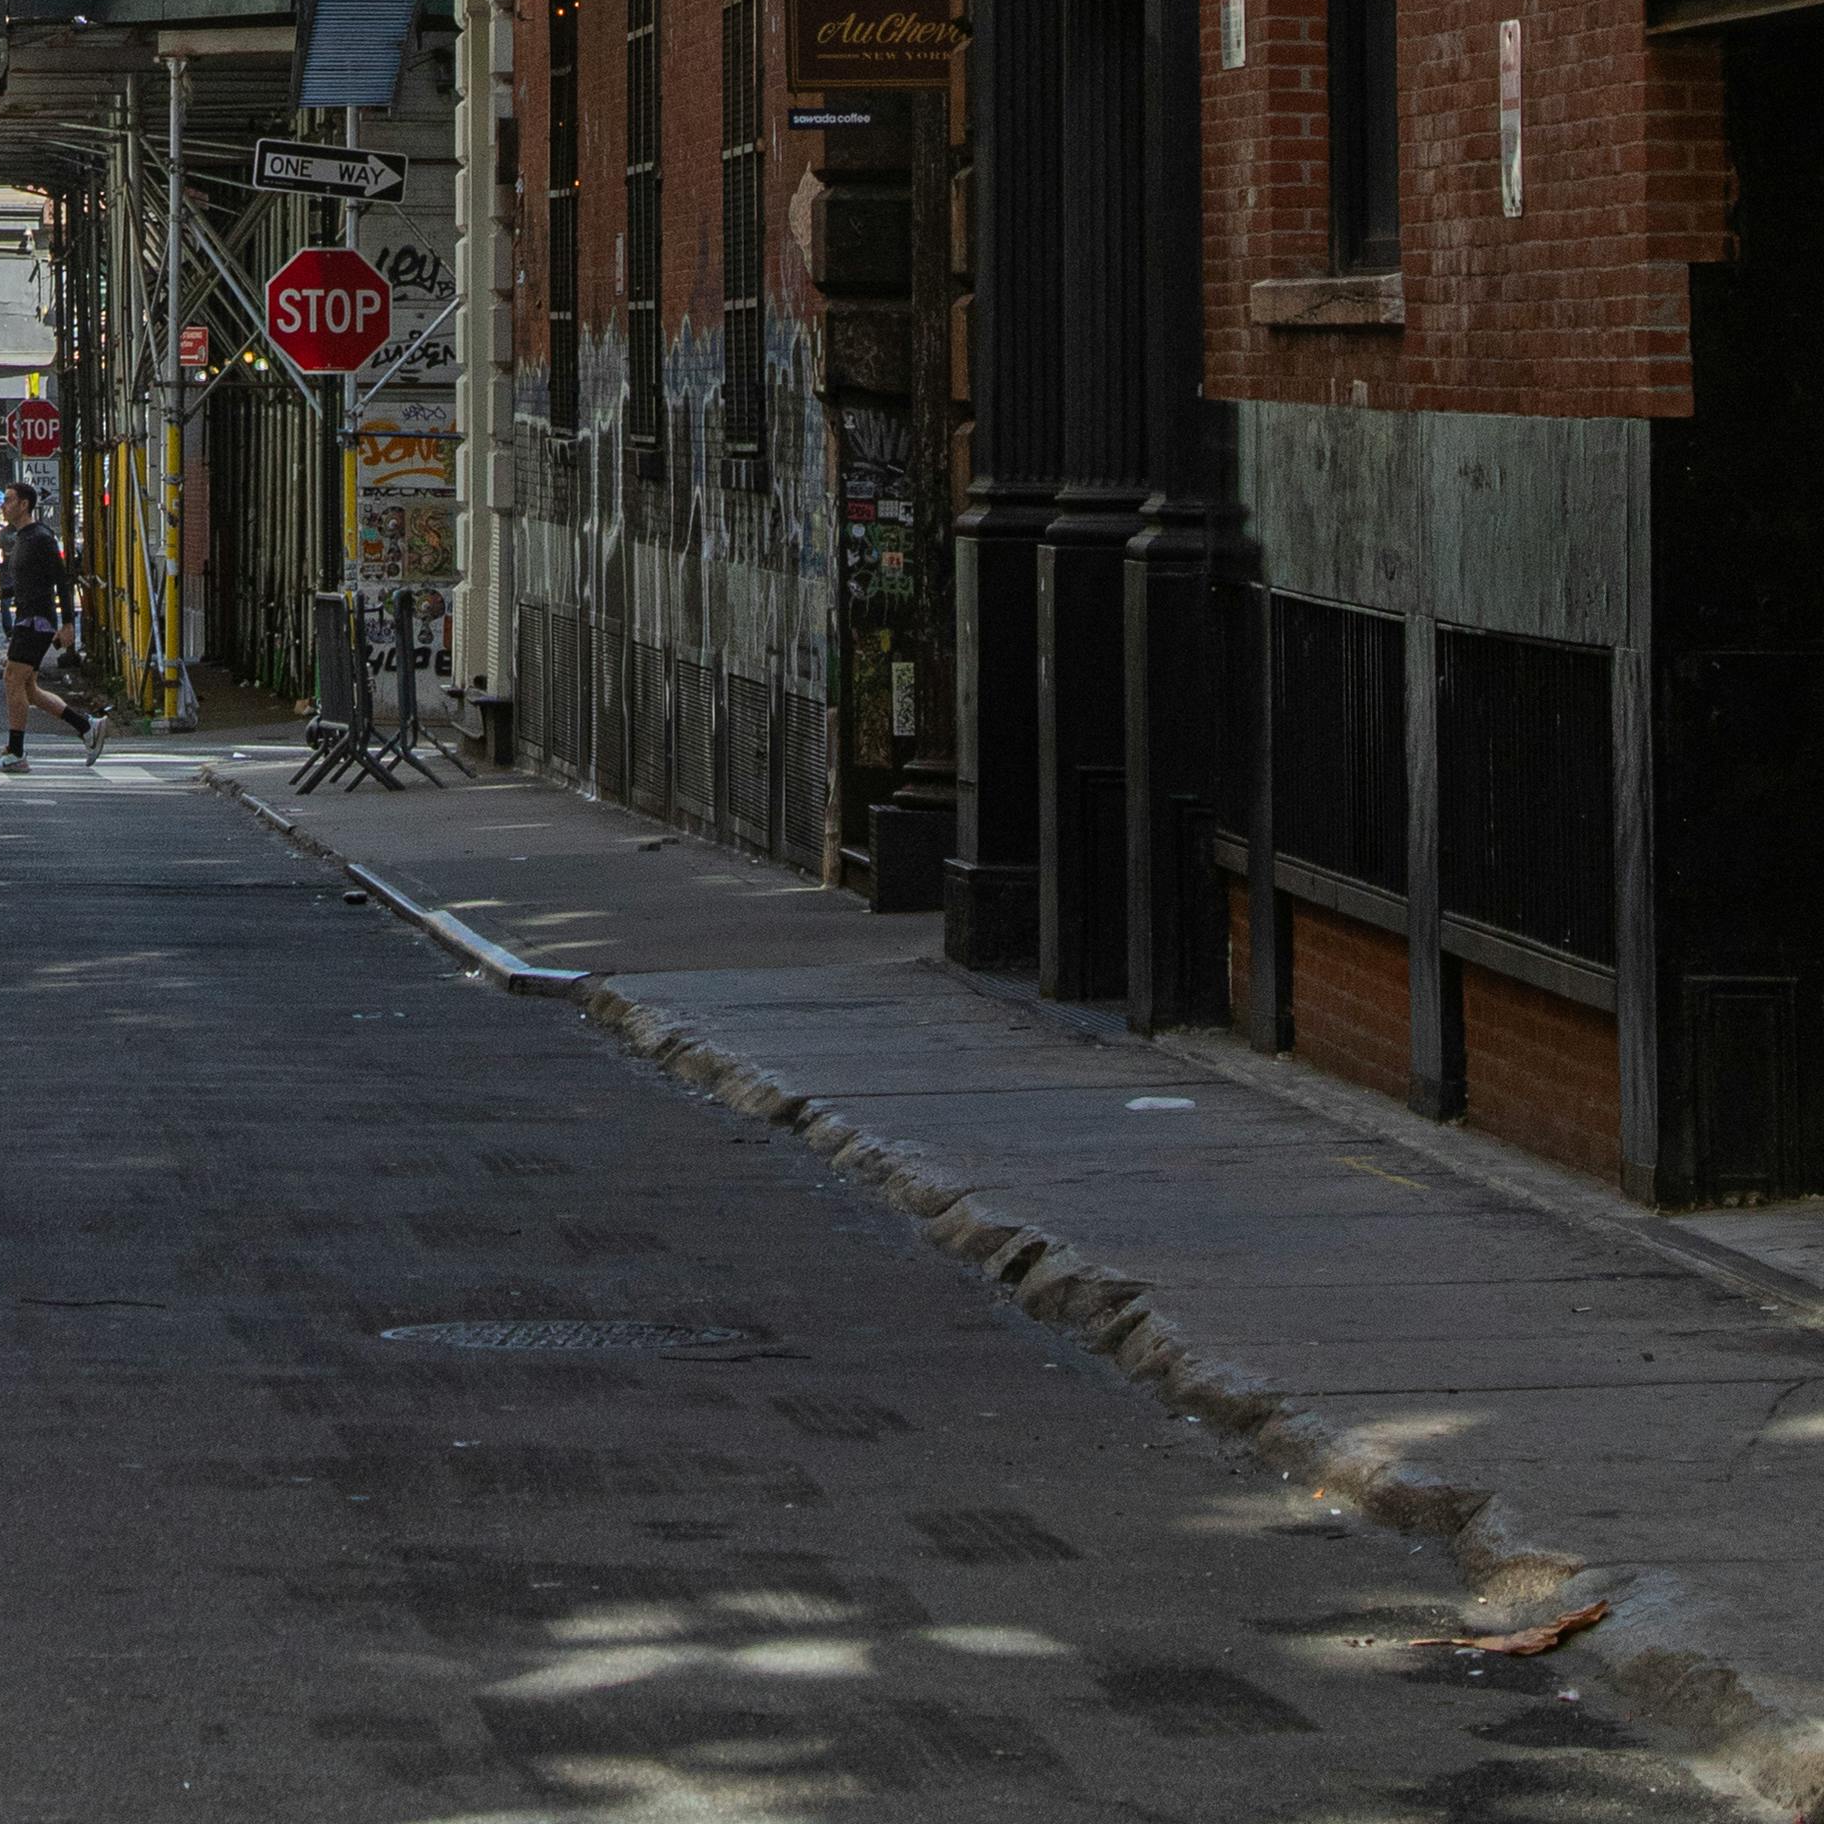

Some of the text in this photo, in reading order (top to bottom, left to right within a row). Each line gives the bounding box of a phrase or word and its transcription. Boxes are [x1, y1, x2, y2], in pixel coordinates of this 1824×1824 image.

[817, 12, 876, 44] Au
[862, 51, 897, 61] NEW
[793, 112, 872, 124] sawada coffee
[270, 156, 386, 185] ONE WAY
[277, 288, 382, 333] STOP
[13, 418, 60, 440] STOP
[25, 463, 49, 474] ALL
[23, 476, 56, 487] RAFFIC
